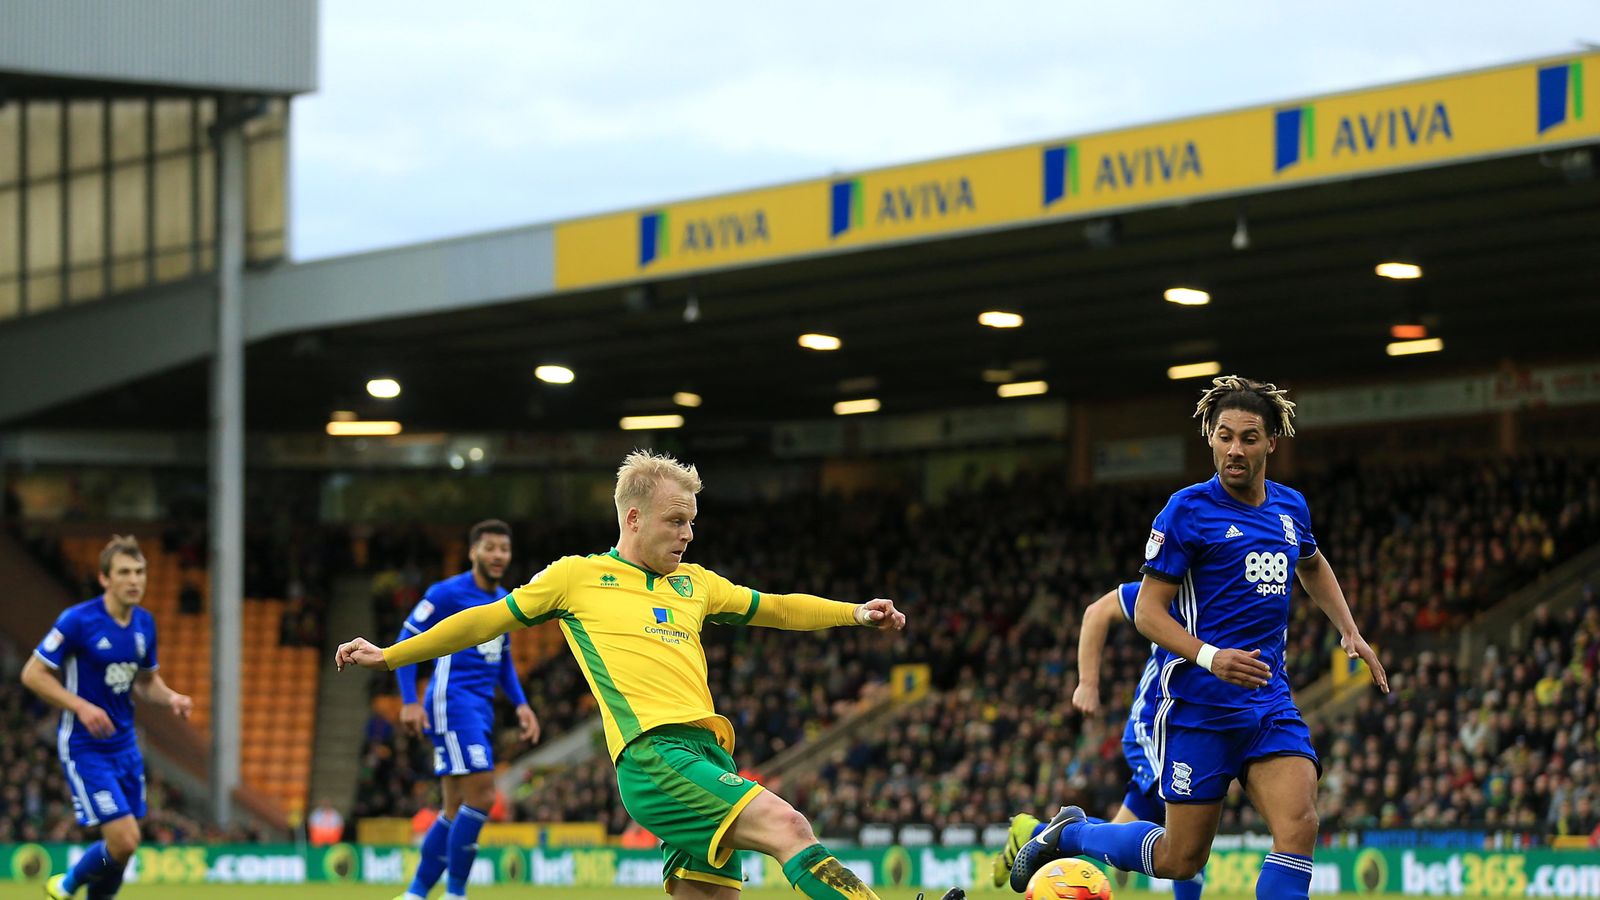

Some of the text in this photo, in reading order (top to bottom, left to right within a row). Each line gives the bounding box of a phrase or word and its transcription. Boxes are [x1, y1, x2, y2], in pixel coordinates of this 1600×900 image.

[1333, 101, 1454, 156] AVIVA
[1095, 141, 1204, 190] AVIVA
[879, 176, 976, 222] AVIVA
[682, 210, 770, 252] AVIVA
[1245, 551, 1288, 583] 888
[1256, 582, 1287, 596] sport
[644, 625, 690, 640] Community
[661, 635, 680, 644] Fund
